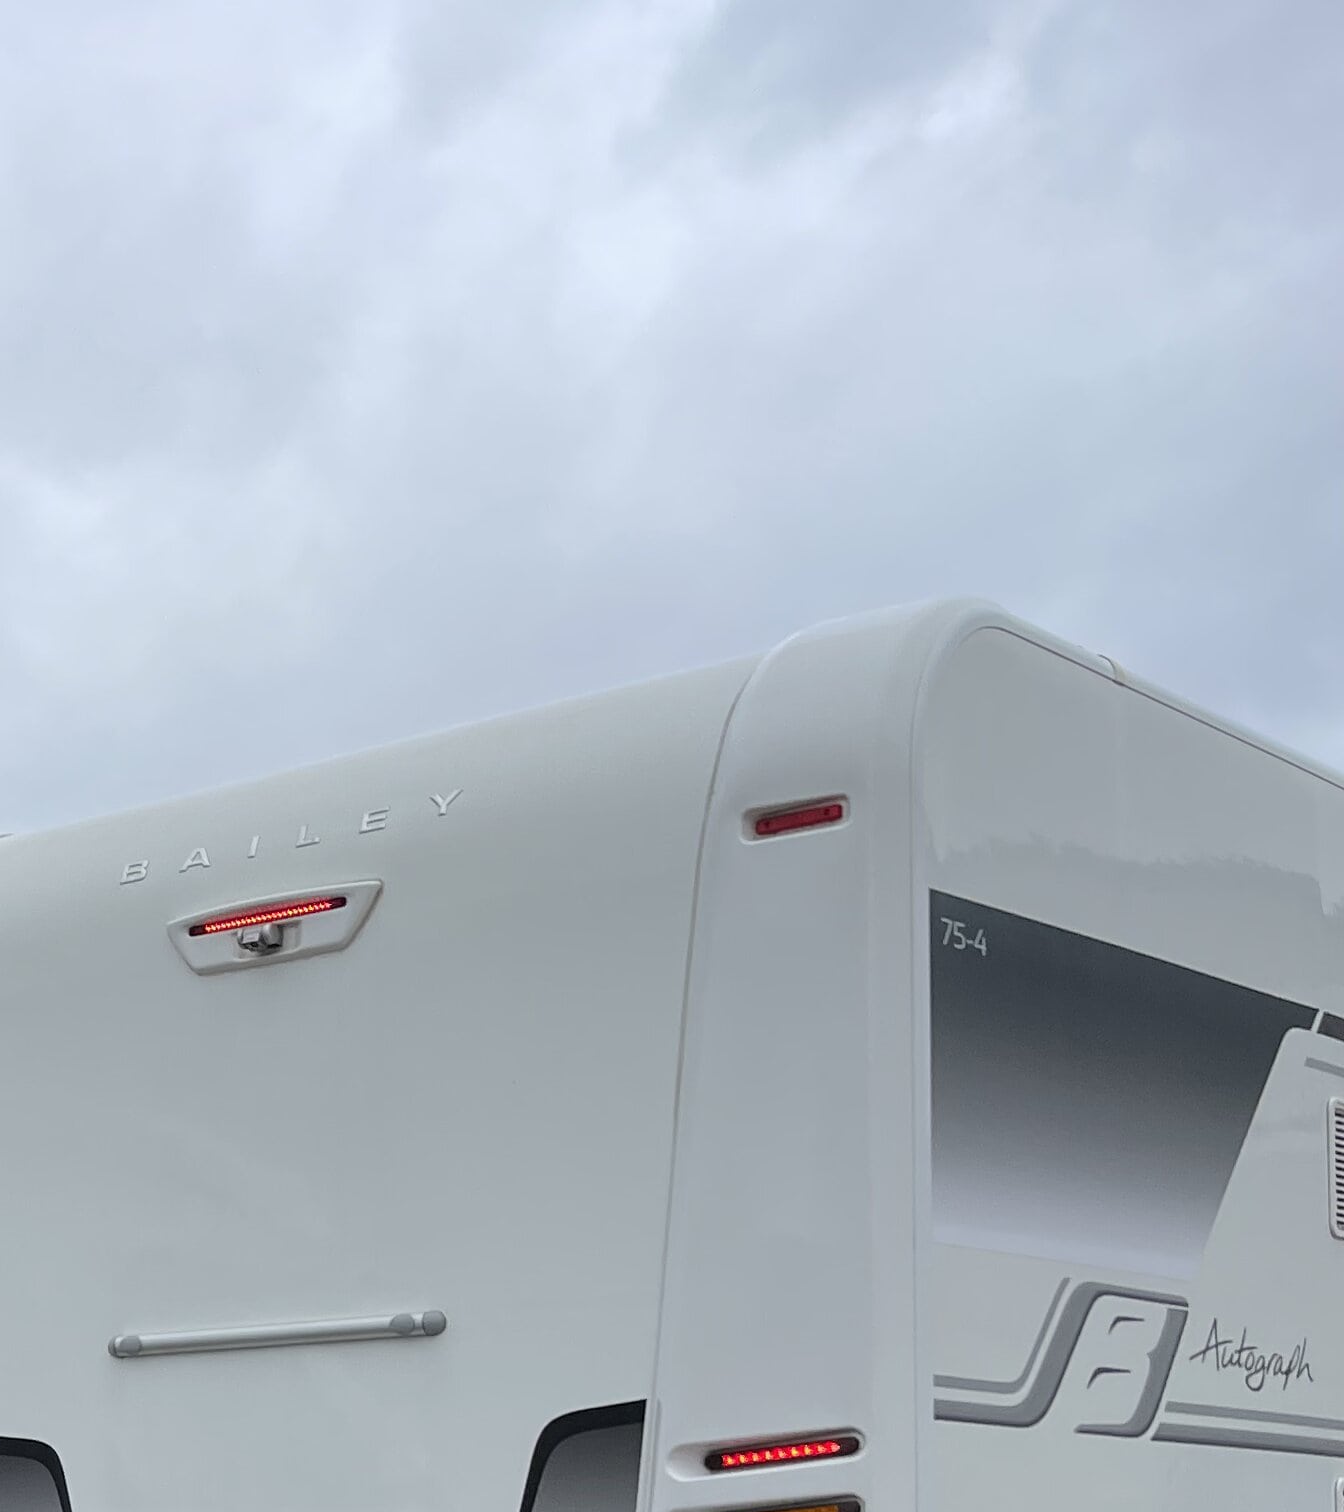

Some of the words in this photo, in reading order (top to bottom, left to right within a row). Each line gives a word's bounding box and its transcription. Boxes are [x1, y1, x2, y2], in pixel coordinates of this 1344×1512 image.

[120, 788, 464, 885] BAILEY
[940, 916, 987, 956] 75-4
[1189, 1317, 1314, 1391] Autograph
